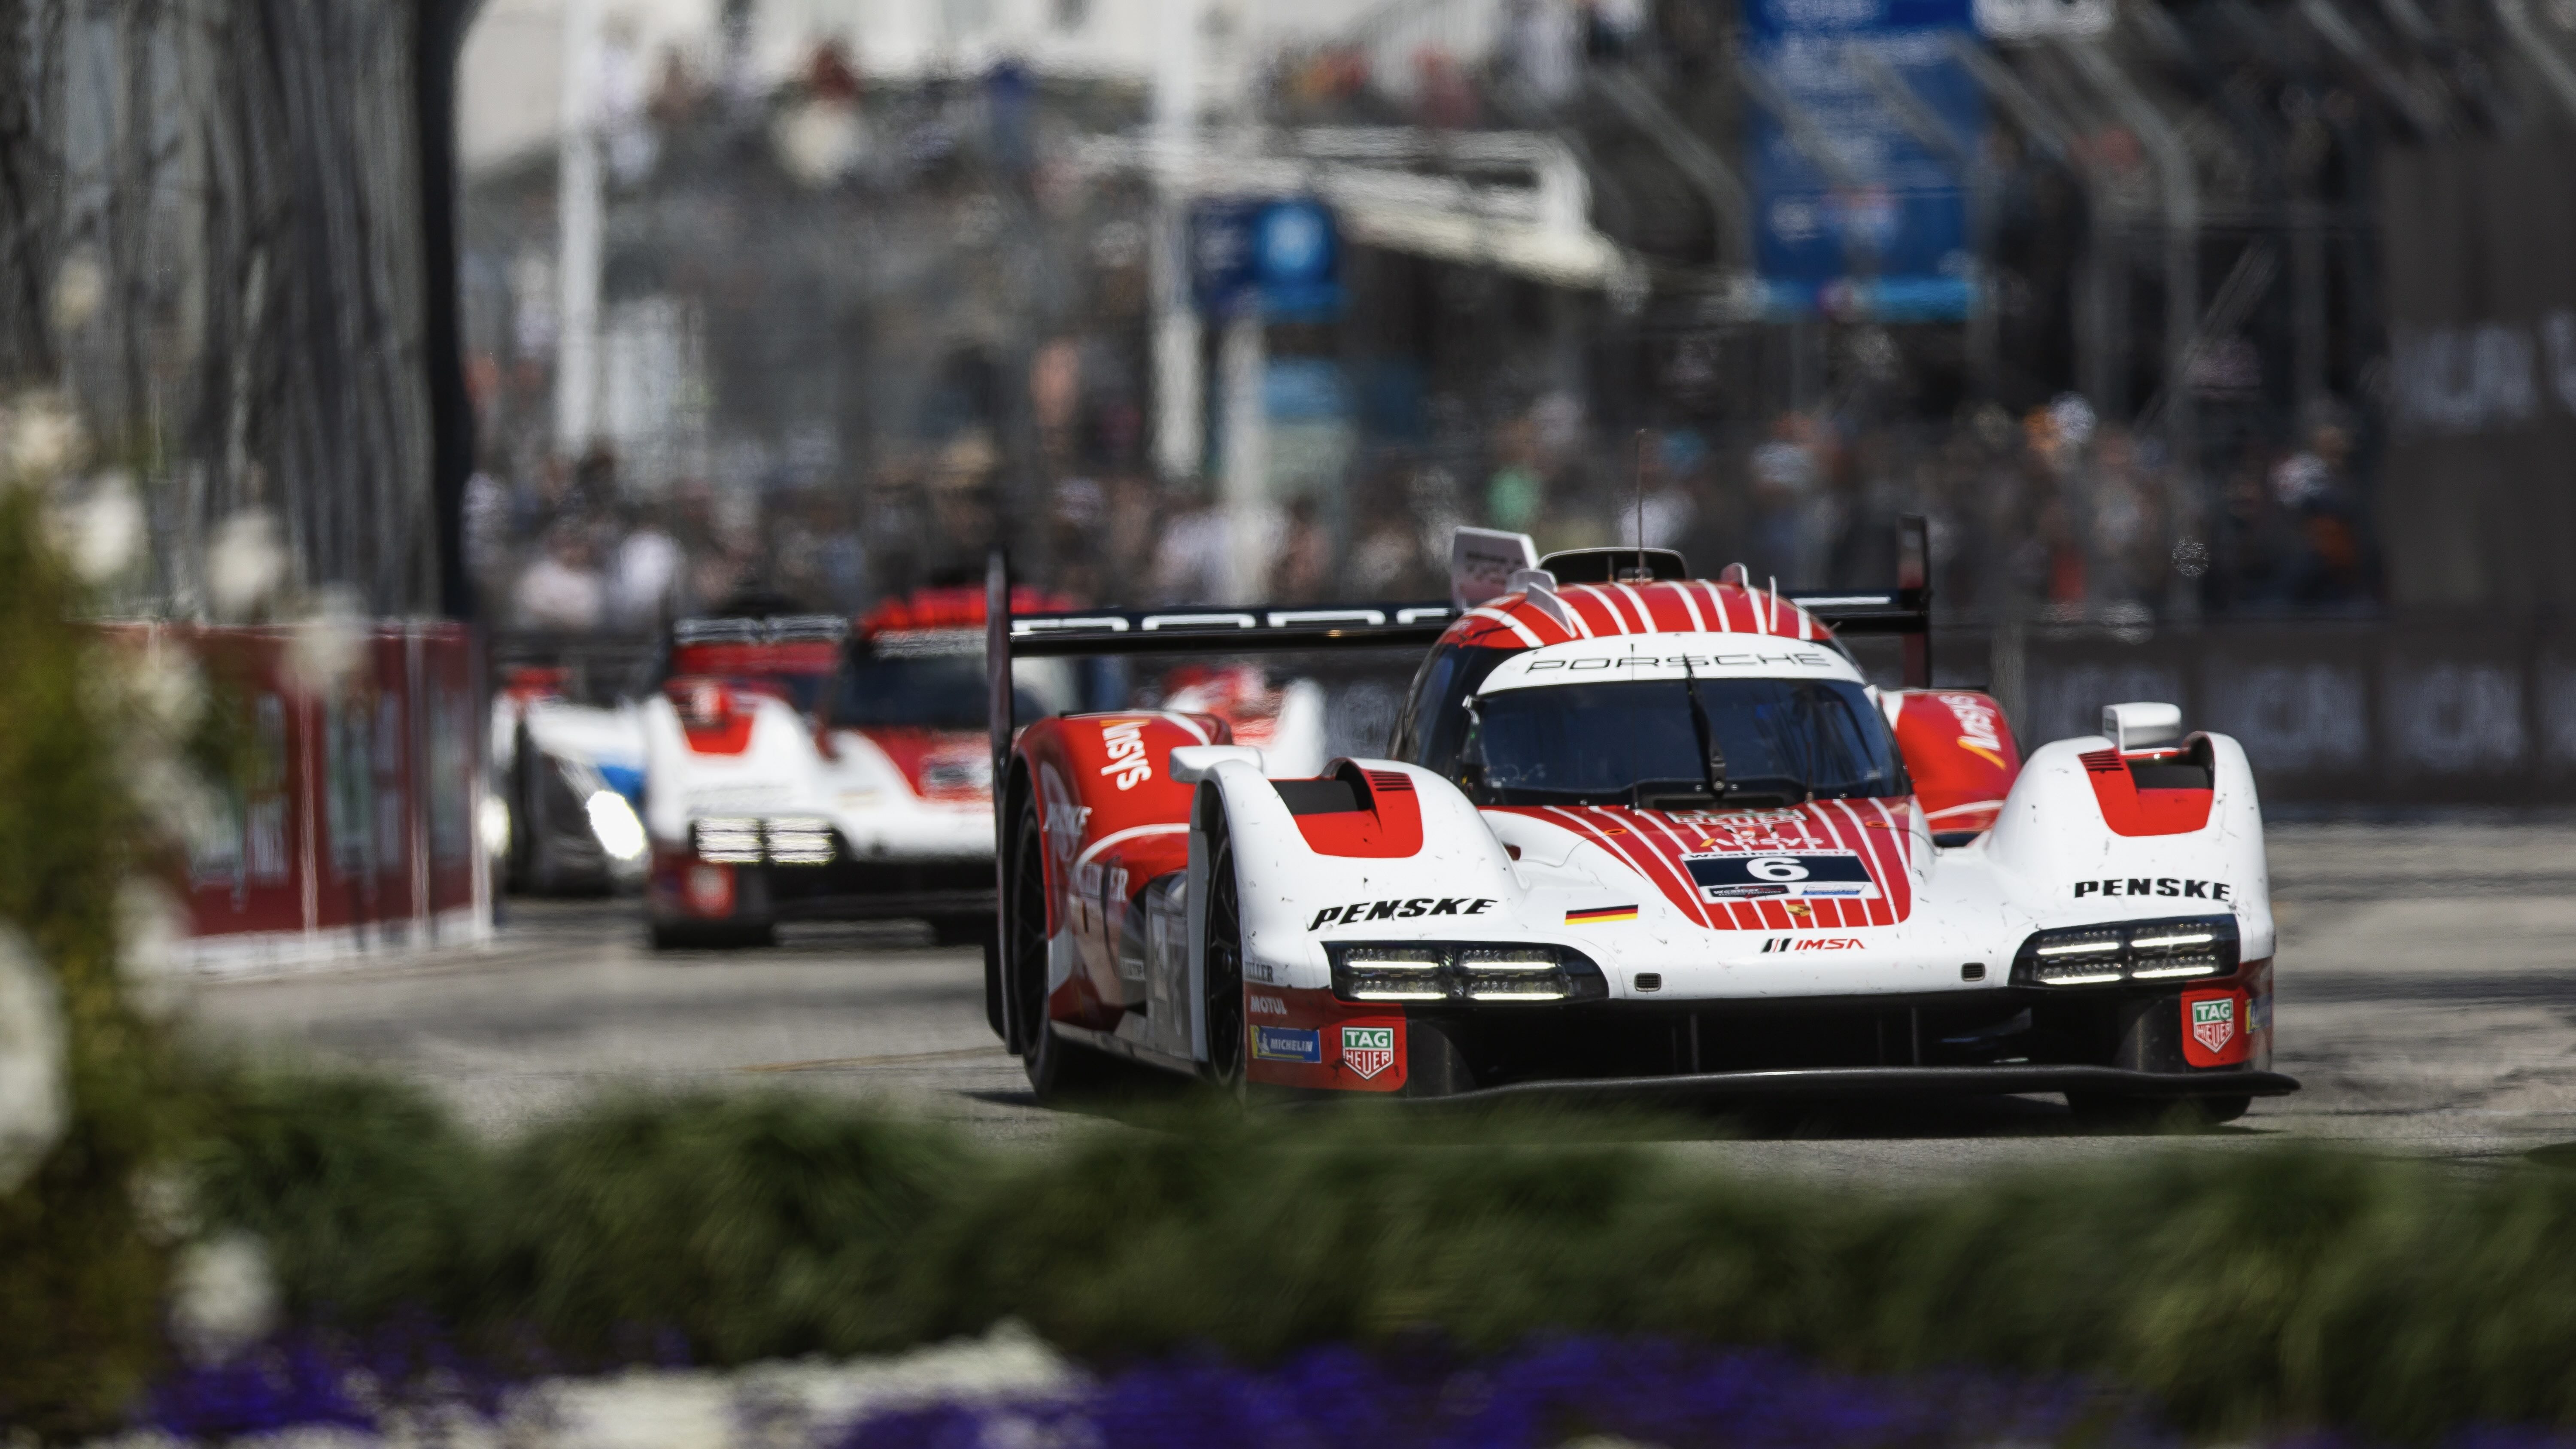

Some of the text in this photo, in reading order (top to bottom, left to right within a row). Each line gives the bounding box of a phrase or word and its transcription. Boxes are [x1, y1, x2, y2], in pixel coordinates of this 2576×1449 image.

[1525, 653, 1832, 674] PORSCHE
[1746, 857, 1810, 881] 6
[2074, 878, 2232, 902] PENSKE
[1307, 898, 1499, 931] PENSKE
[1794, 939, 1865, 950] IMSA
[1250, 995, 1288, 1015] MOTUL
[2196, 1003, 2230, 1021] TAG
[1270, 1038, 1313, 1052] MICHELIN
[1346, 1031, 1388, 1047] TAG
[2196, 1023, 2231, 1047] HEUER
[1346, 1051, 1389, 1074] HEUER
